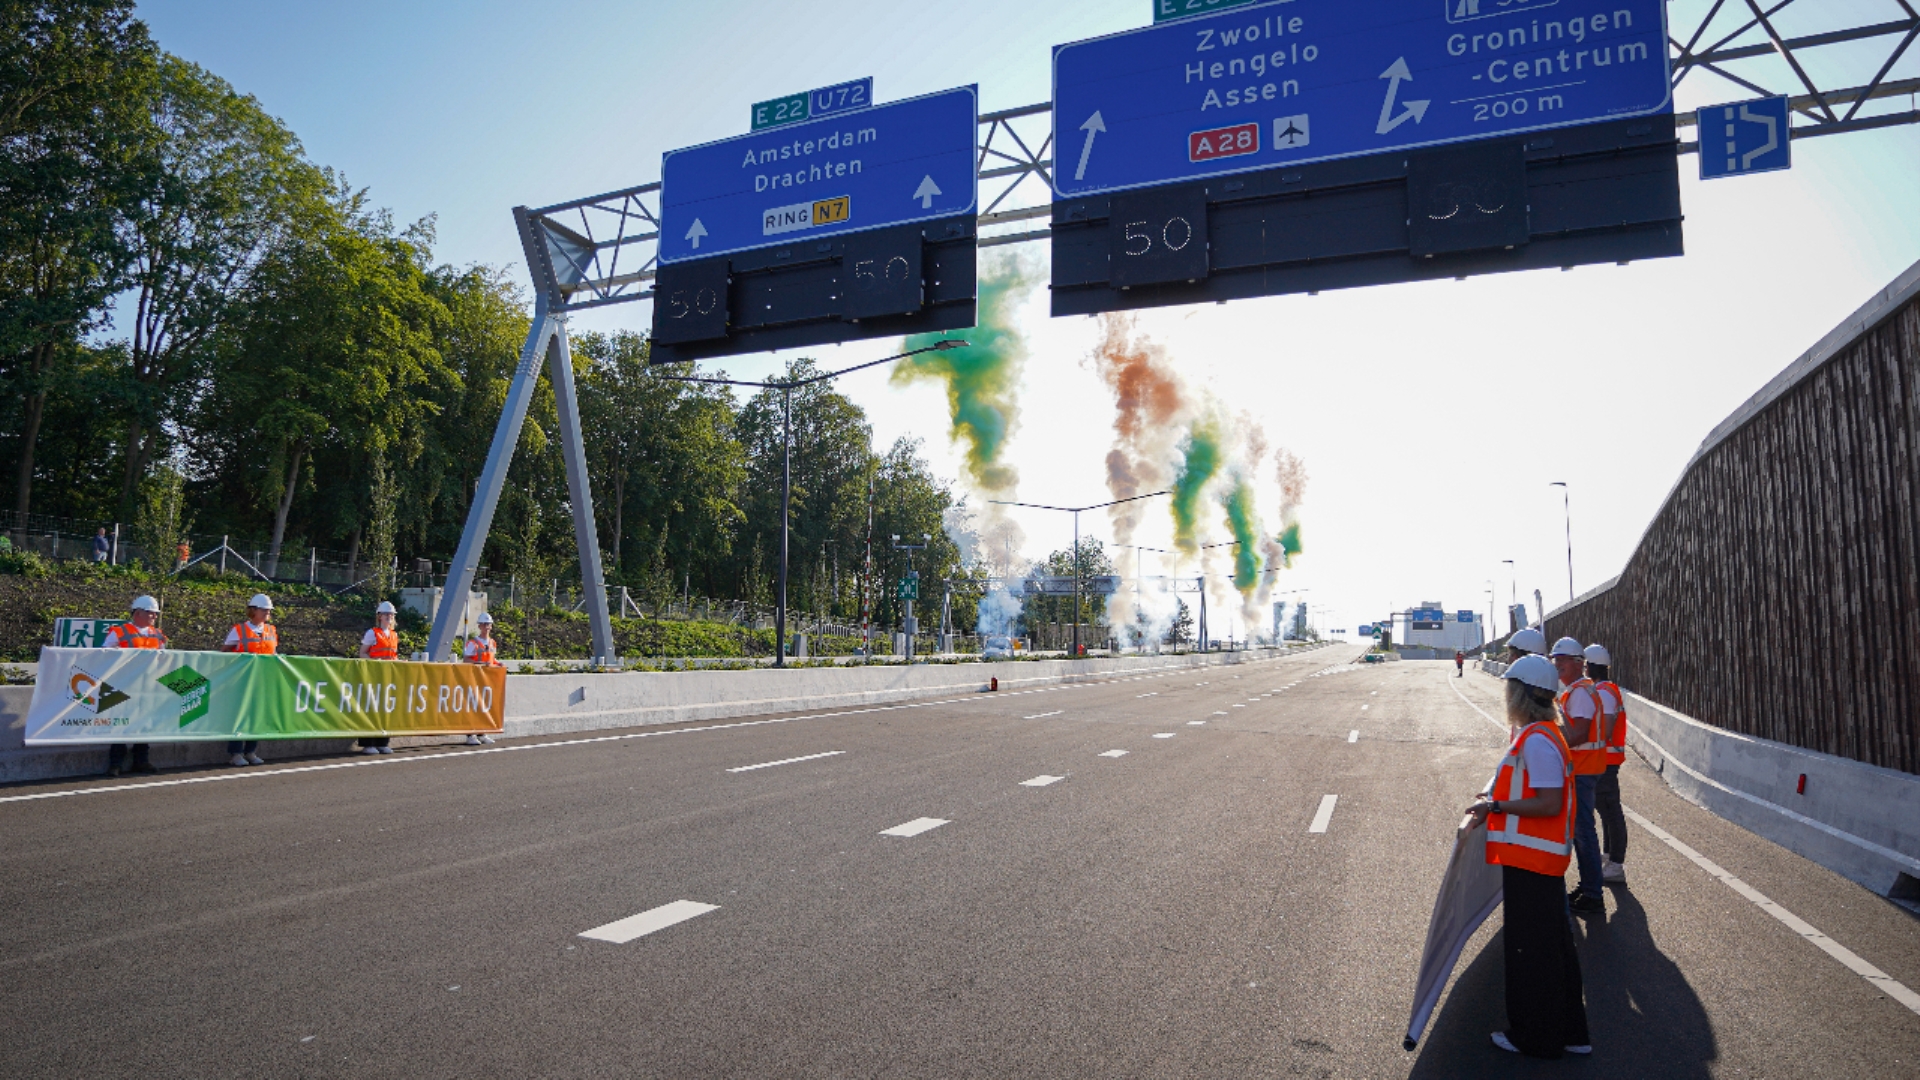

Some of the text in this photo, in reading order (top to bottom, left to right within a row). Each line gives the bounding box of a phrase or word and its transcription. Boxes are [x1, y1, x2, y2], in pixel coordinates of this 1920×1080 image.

[1196, 16, 1304, 52] Zwolle
[1446, 9, 1633, 56] Groningen
[1185, 43, 1319, 84] Hengelo
[1471, 40, 1648, 83] -Centrum
[818, 84, 865, 110] U72
[1200, 79, 1300, 111] Assen
[1473, 94, 1564, 122] 200 m
[742, 127, 877, 169] Amsterdam
[1195, 131, 1252, 155] A28
[755, 156, 863, 193] Drachten
[765, 208, 809, 230] RING
[819, 202, 844, 220] N7
[1125, 216, 1192, 256] 50
[670, 288, 717, 319] 50
[295, 679, 493, 714] DE RING IS ROND
